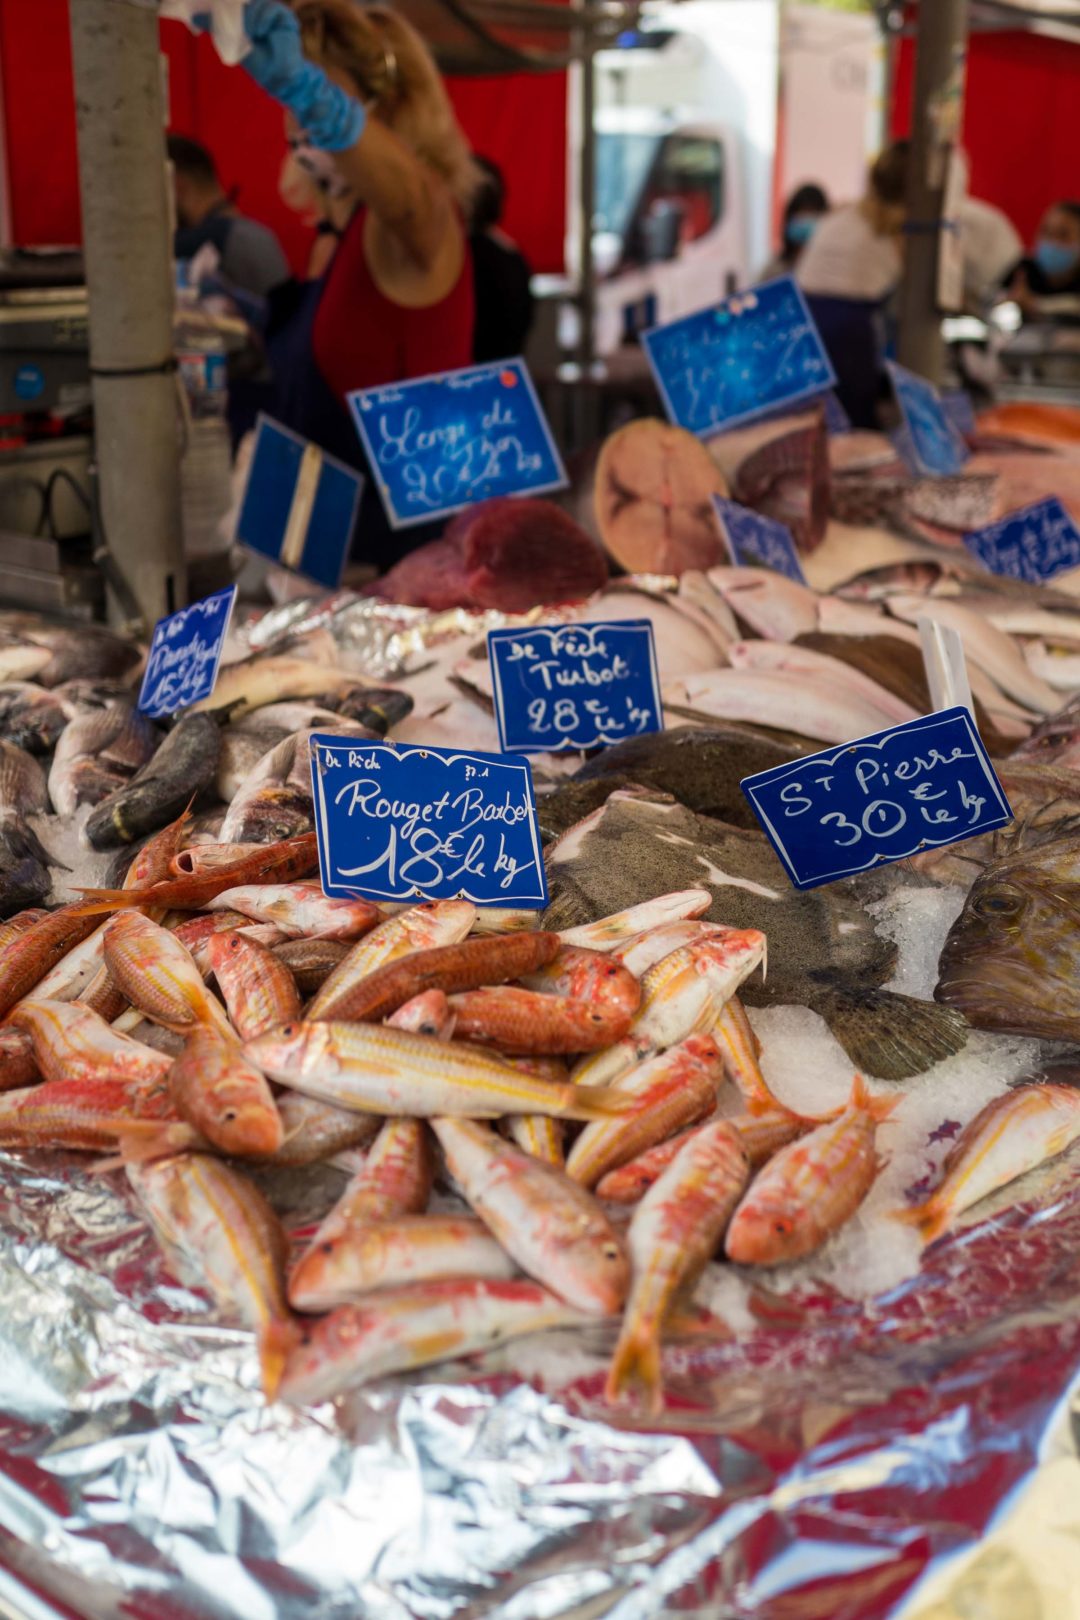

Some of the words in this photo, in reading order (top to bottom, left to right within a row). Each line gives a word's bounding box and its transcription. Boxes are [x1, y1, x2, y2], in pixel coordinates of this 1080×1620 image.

[529, 654, 630, 691] Turbot
[855, 746, 976, 794] Pierre
[335, 778, 450, 839] Rouget
[493, 832, 536, 888] kg
